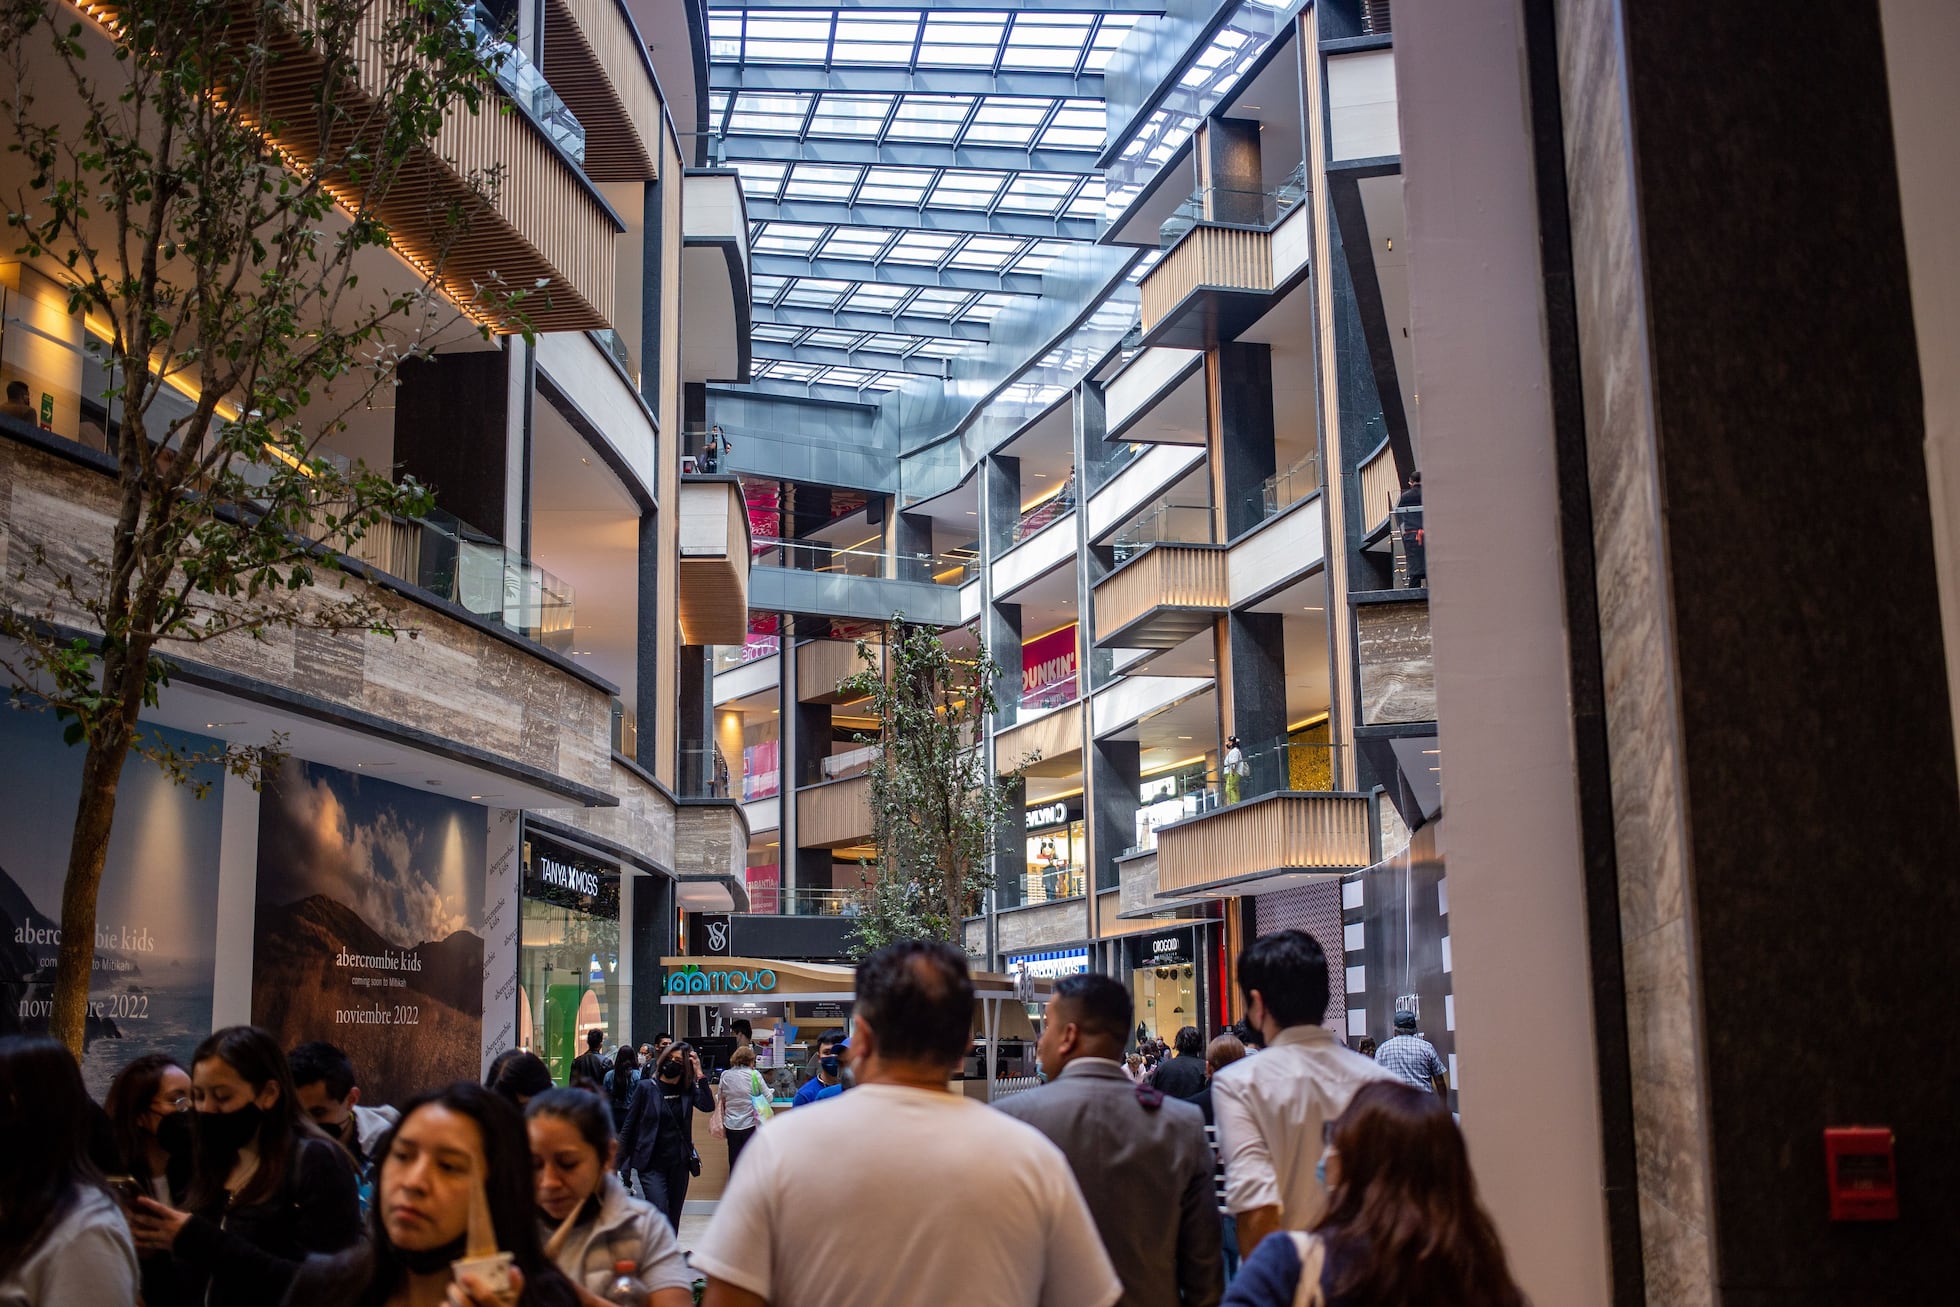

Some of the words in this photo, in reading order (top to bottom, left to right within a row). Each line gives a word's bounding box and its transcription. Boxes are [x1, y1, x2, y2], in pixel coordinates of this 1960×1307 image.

[541, 857, 568, 888] TANYA
[576, 869, 599, 896] MOSS
[14, 917, 118, 949] abercbie
[121, 926, 154, 951] kids
[39, 958, 58, 968] com
[336, 946, 399, 970] abercrombie
[400, 951, 422, 972] kids
[351, 976, 370, 988] coming
[18, 993, 105, 1018] novire
[109, 994, 149, 1019] 2022
[336, 1002, 392, 1025] noviembre
[393, 1005, 420, 1025] 2022
